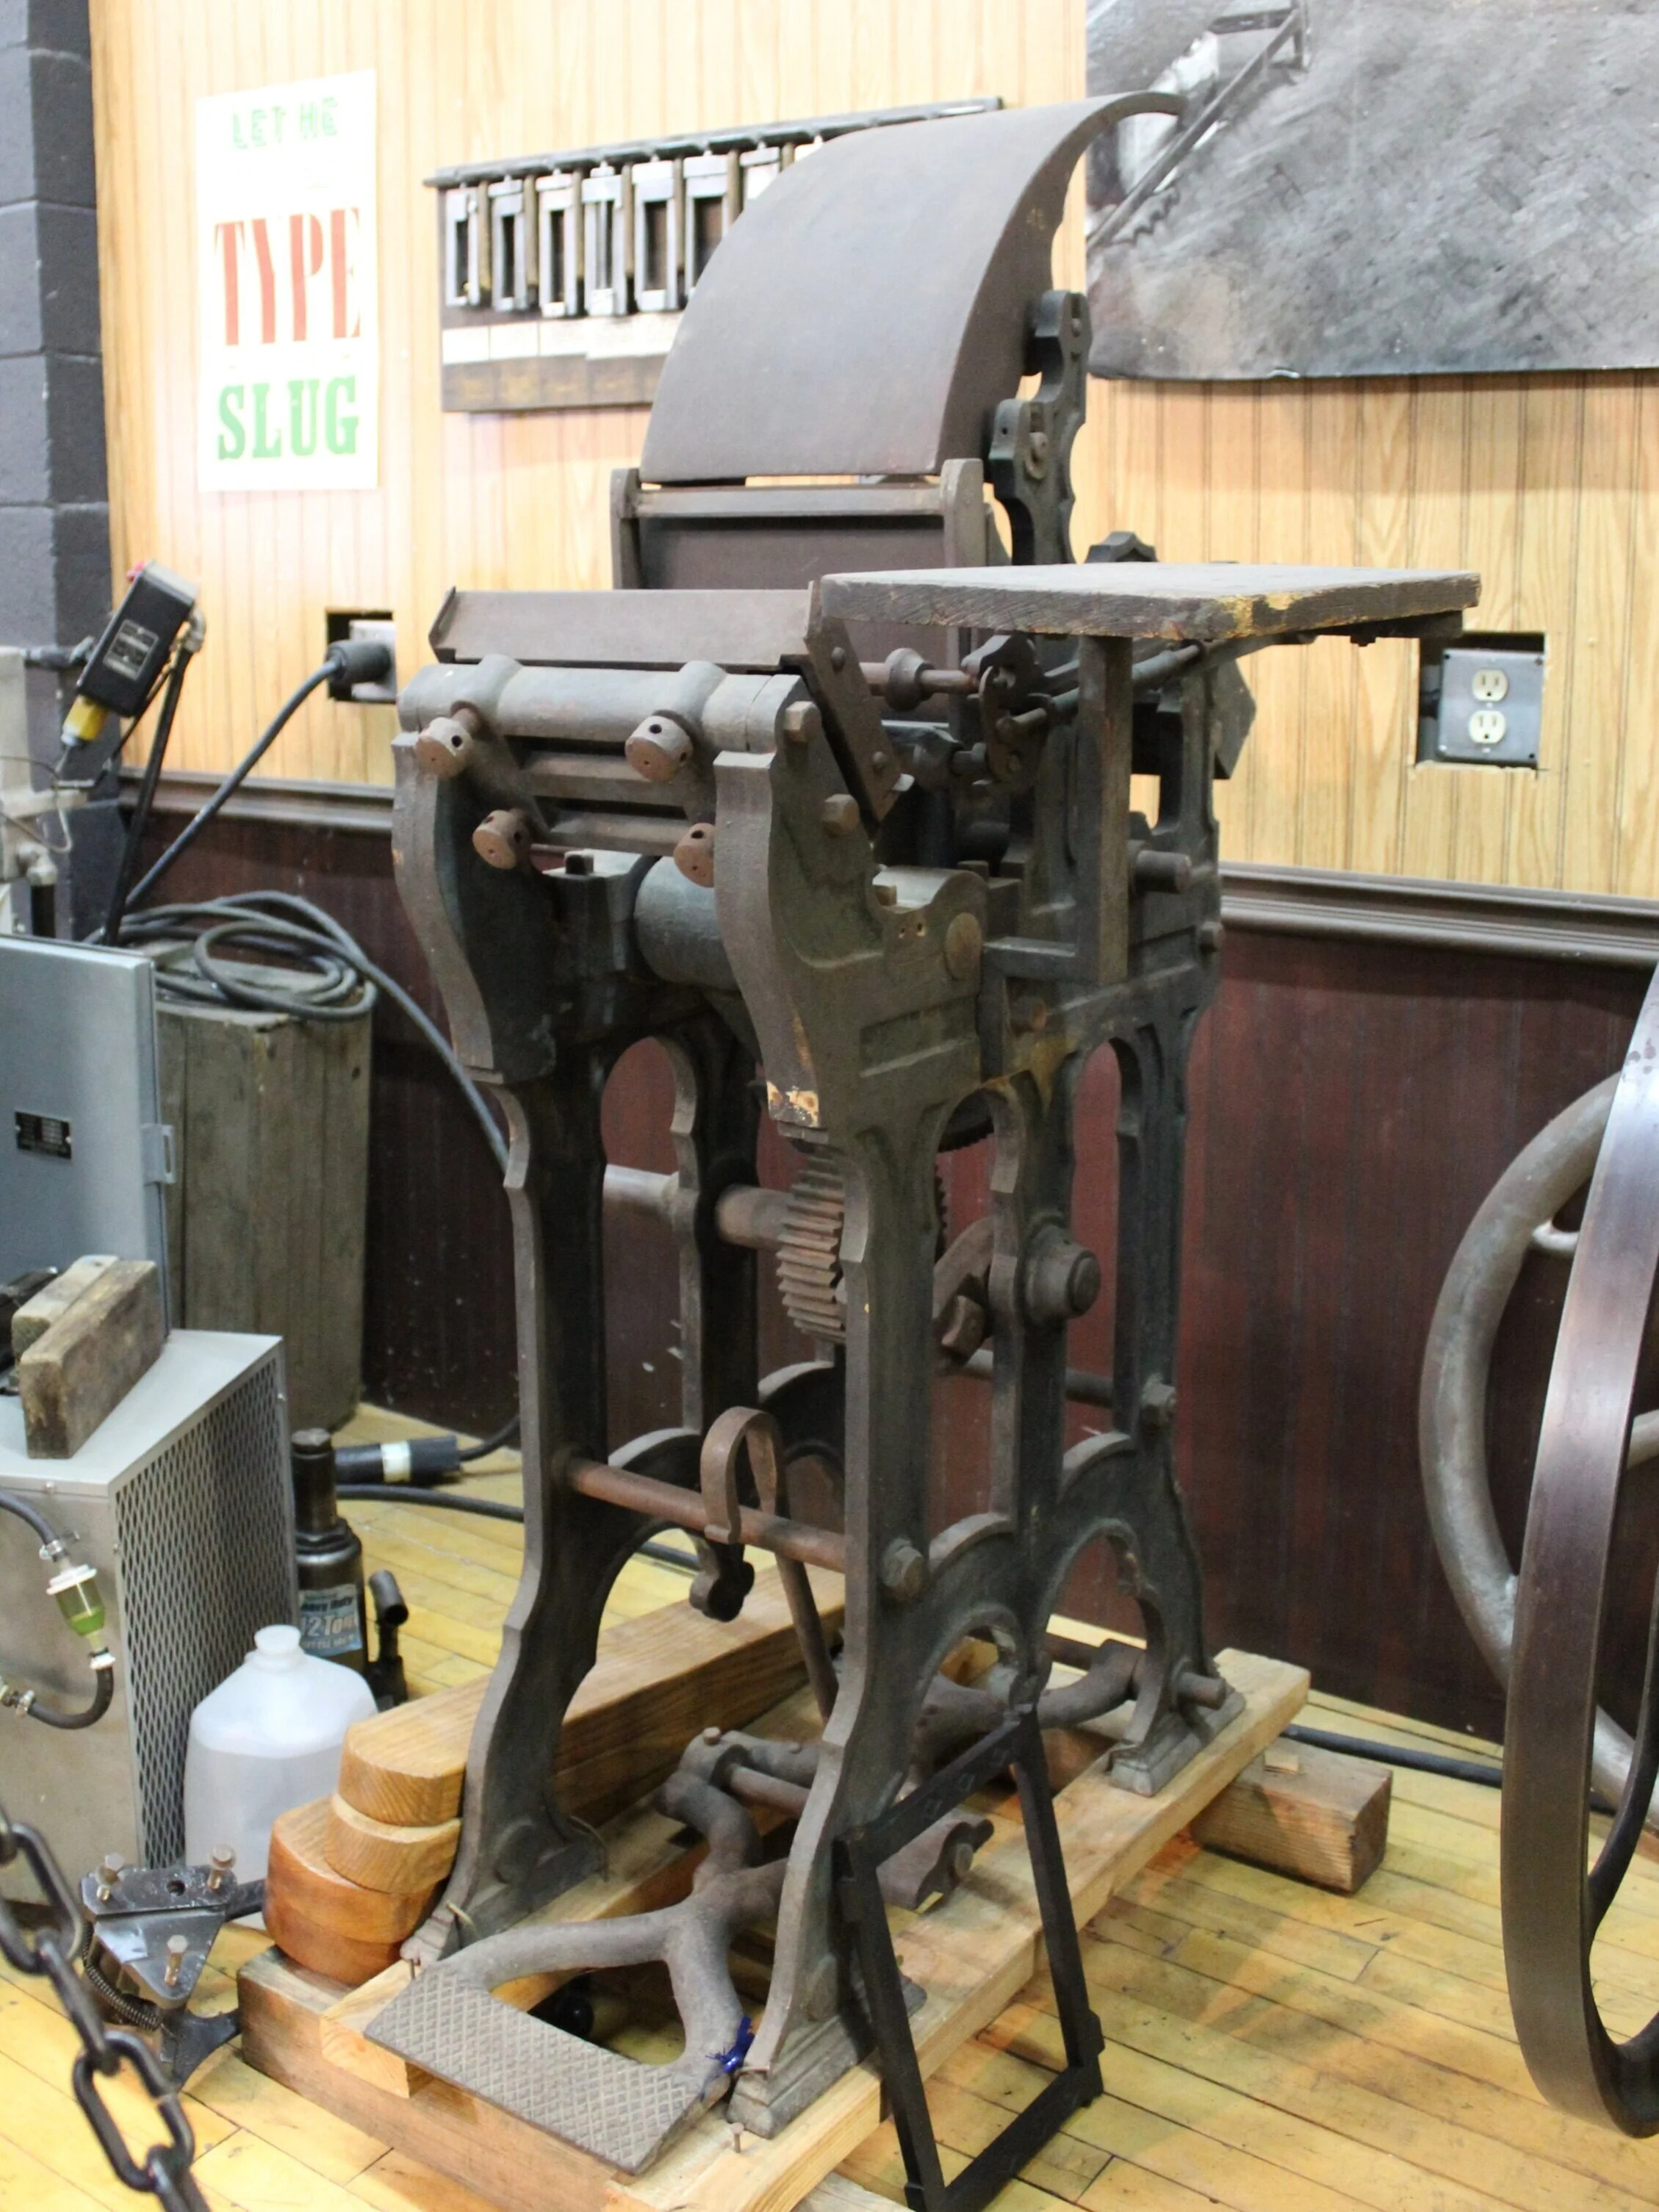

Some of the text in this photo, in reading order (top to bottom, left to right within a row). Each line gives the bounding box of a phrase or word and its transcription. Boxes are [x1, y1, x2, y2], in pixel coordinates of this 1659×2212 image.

[231, 96, 339, 150] LET HE
[214, 206, 361, 347] TYPE
[216, 375, 359, 461] SLUG
